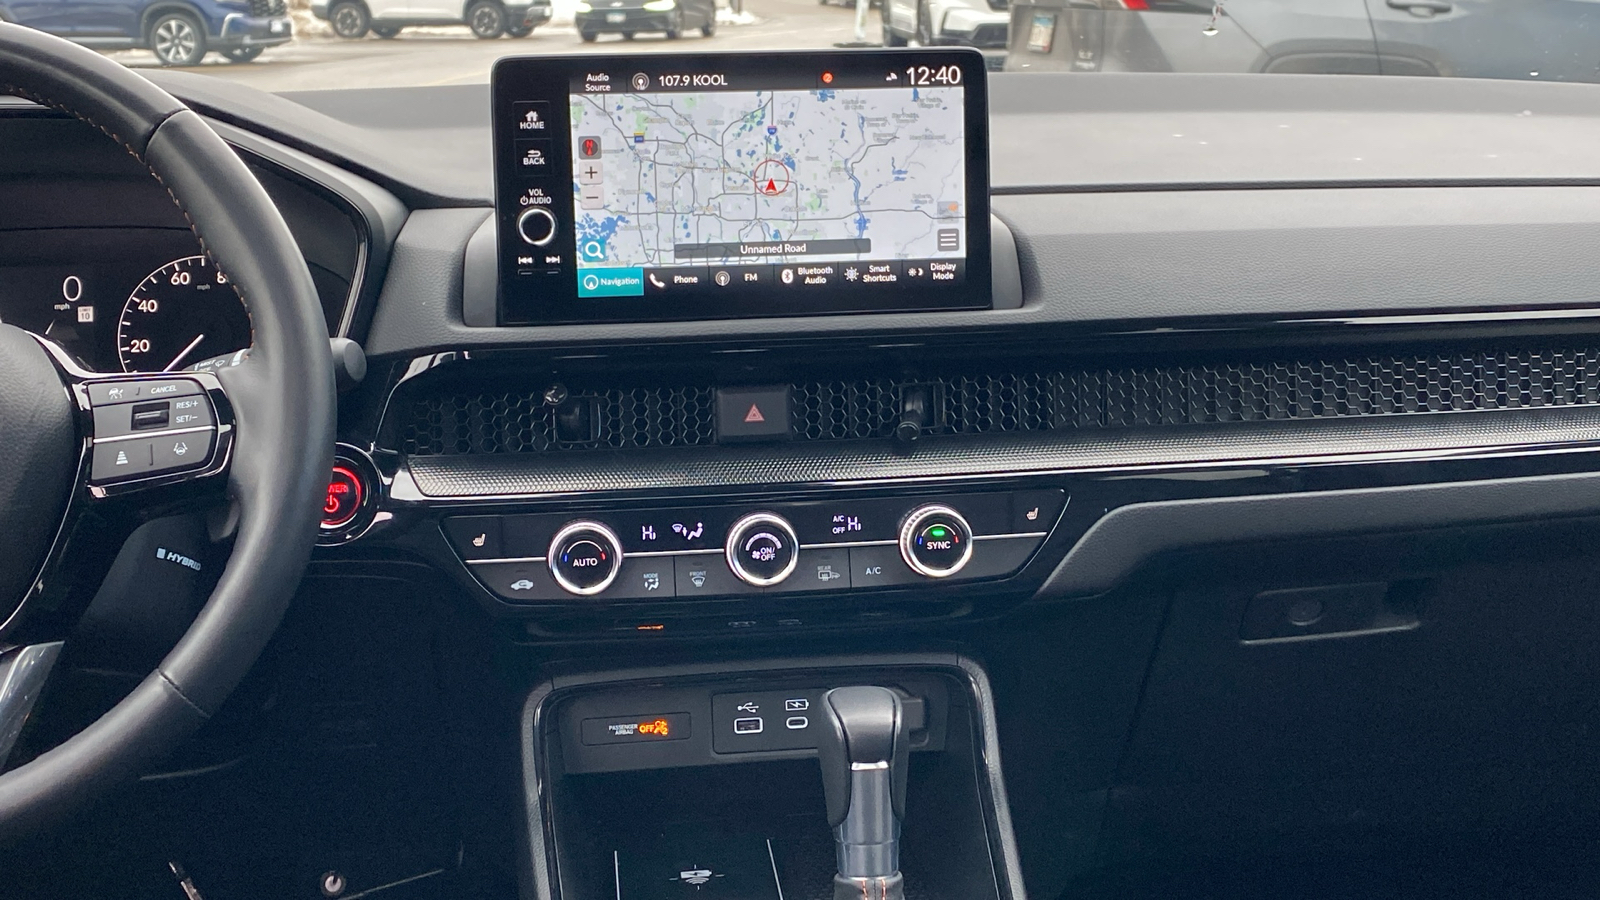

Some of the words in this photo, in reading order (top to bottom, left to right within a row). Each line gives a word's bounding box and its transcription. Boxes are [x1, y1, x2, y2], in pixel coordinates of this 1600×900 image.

[586, 73, 609, 82] Audio
[906, 65, 961, 85] 12:40
[658, 75, 690, 87] 107.9
[693, 74, 728, 86] KOOL
[585, 84, 611, 92] Source
[519, 121, 545, 130] HOME
[523, 157, 545, 165] BACK
[528, 188, 544, 196] VOL
[529, 196, 552, 205] AUDIO
[740, 243, 782, 255] Unnamed
[784, 243, 807, 253] Road
[797, 266, 833, 275] Bluetooth
[868, 264, 890, 273] Smart
[930, 262, 957, 272] Display
[170, 272, 190, 285] 60
[216, 271, 226, 284] 8
[673, 274, 698, 284] Phone
[744, 273, 757, 281] FM
[804, 275, 827, 285] Audio
[862, 273, 897, 283] Shortcuts
[932, 271, 954, 281] Mode
[601, 277, 639, 287] Navigation
[63, 276, 81, 301] 0
[54, 302, 70, 311] mph
[137, 299, 158, 313] 40
[81, 312, 90, 320] 10
[130, 339, 150, 353] 20
[150, 384, 177, 394] CANCEL
[176, 400, 198, 409] RES/+
[832, 515, 845, 523] A/C
[832, 526, 845, 534] OFF
[926, 540, 951, 550] SYNC
[760, 547, 775, 555] ON/
[166, 551, 202, 571] HYBRID
[572, 557, 598, 567] AUTO
[760, 553, 775, 562] OFF
[865, 566, 881, 576] A/C
[639, 724, 654, 734] OFF
